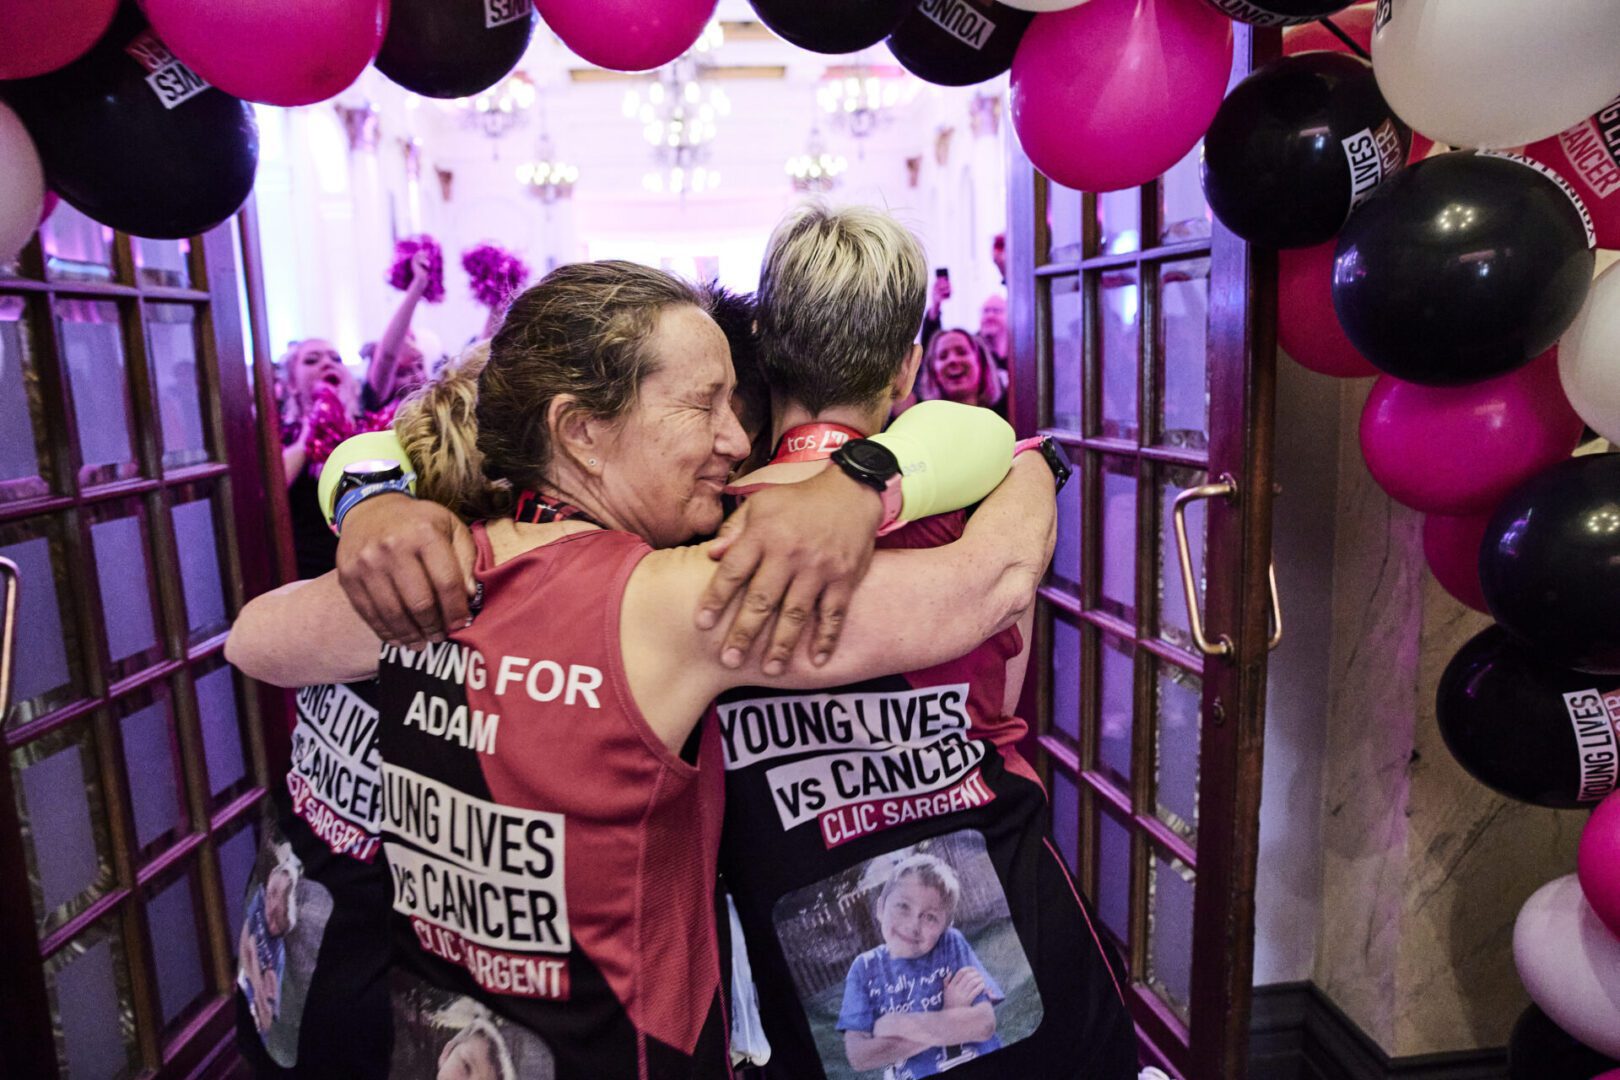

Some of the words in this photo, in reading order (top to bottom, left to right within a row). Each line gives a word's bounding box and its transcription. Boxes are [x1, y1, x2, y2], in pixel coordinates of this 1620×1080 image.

[1348, 136, 1379, 195] LIVES
[1560, 124, 1620, 198] ANCER
[494, 655, 604, 709] FOR
[402, 691, 501, 755] ADAM
[719, 699, 853, 764] YOUNG
[854, 690, 966, 745] LIVES
[1569, 694, 1612, 748] LIVES
[450, 797, 556, 880] LIVES
[822, 805, 878, 845] CLIC
[882, 770, 991, 827] SARGENT
[422, 863, 562, 946] CANCER
